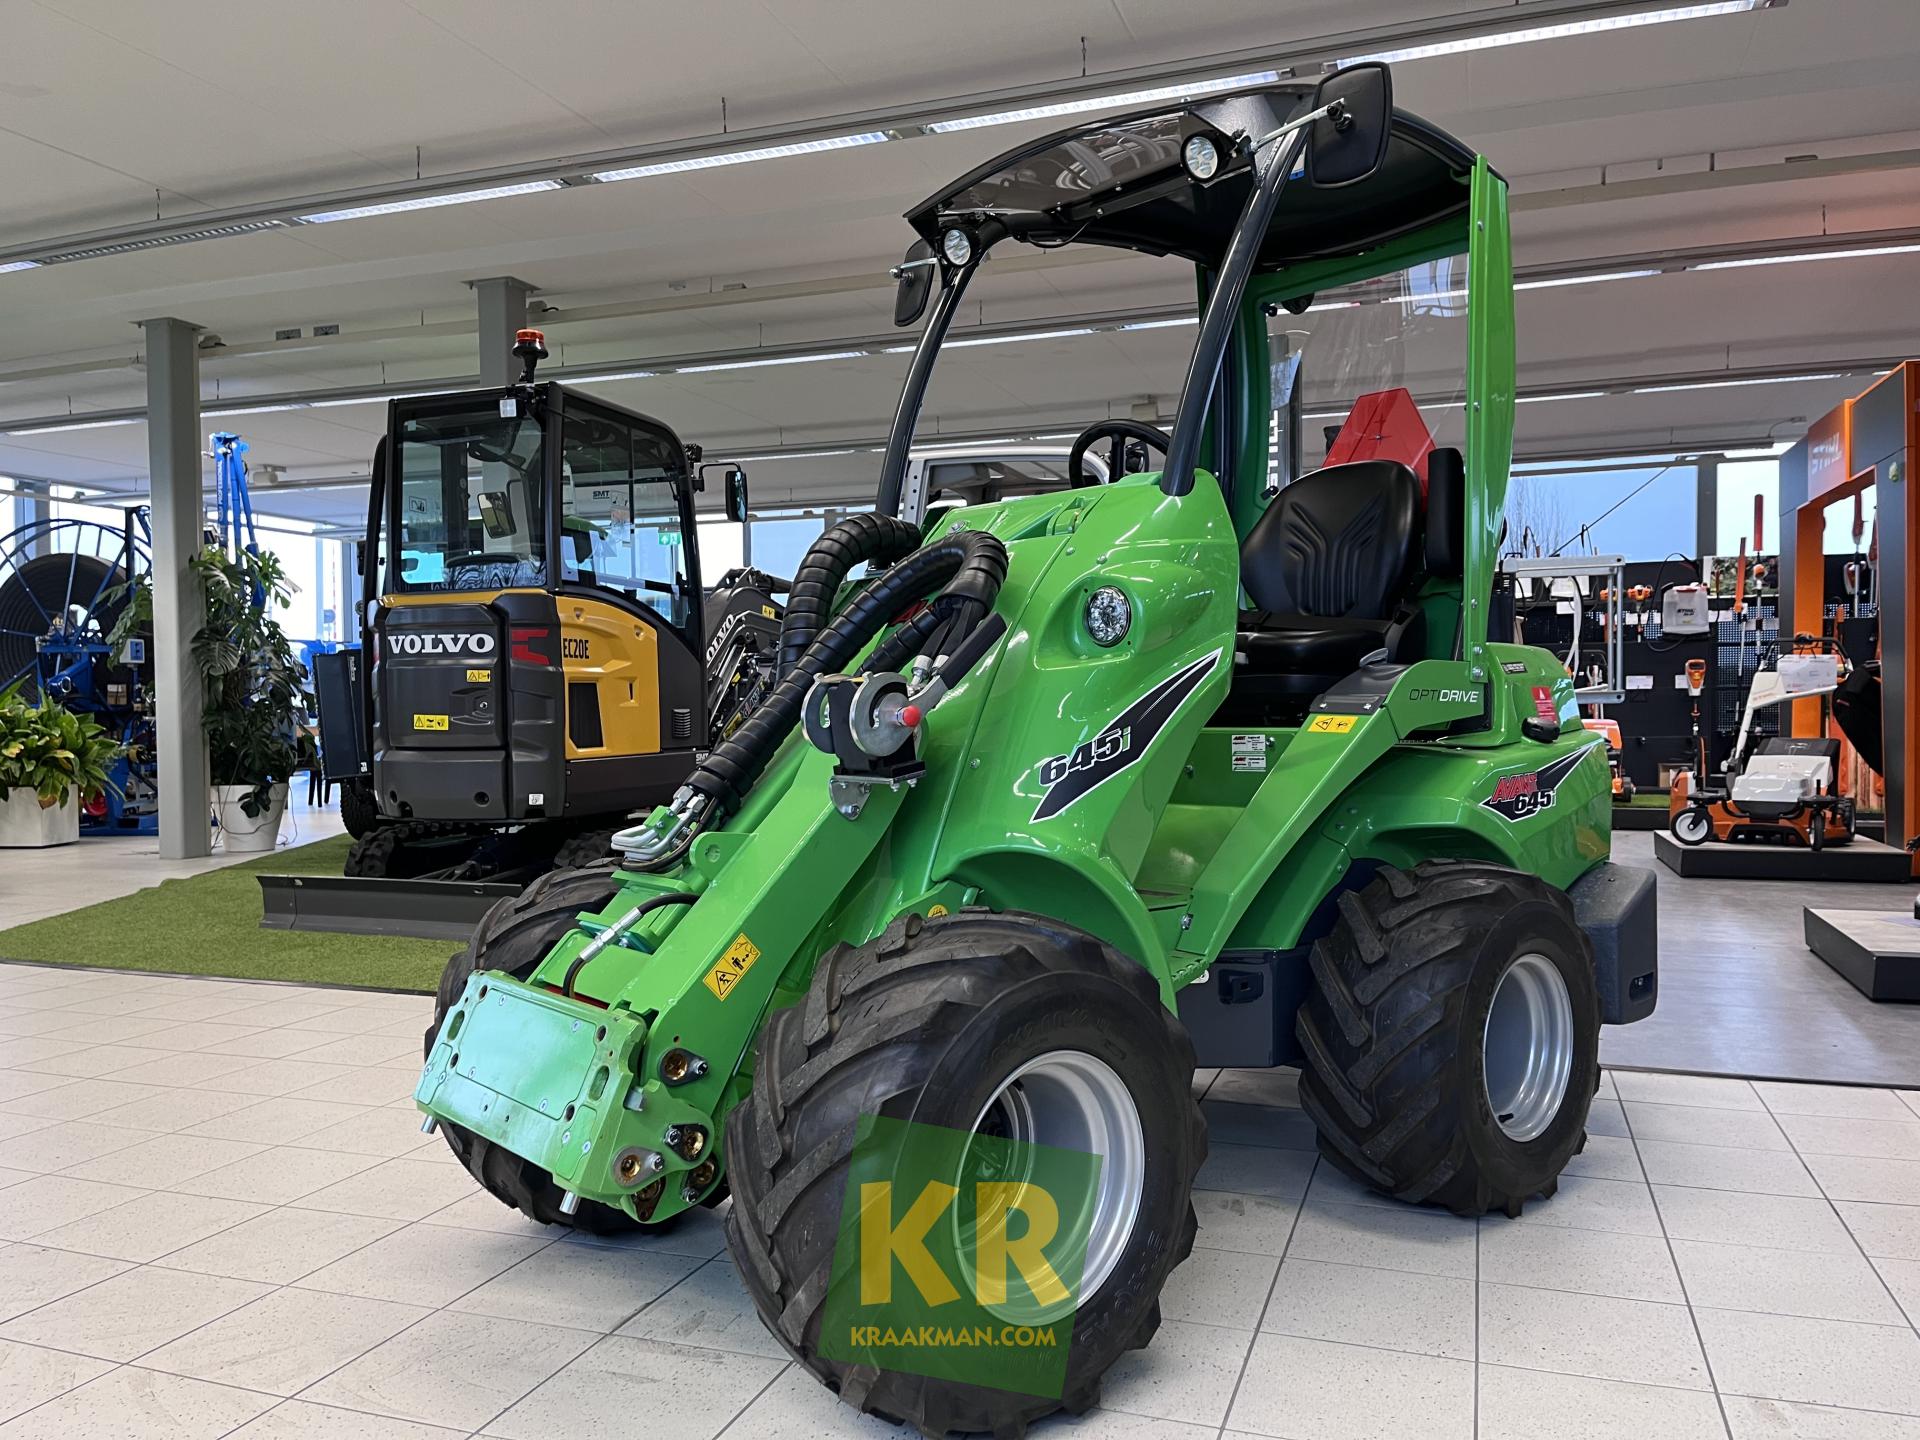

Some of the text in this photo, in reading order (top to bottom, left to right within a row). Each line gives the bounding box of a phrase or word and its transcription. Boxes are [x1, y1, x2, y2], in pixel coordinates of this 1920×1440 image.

[592, 490, 610, 498] SMT
[387, 633, 495, 654] VOLVO
[563, 637, 590, 660] EC20E
[705, 613, 735, 662] OLVO
[1409, 688, 1479, 703] OPTIDRIVE
[1038, 726, 1131, 787] 645i
